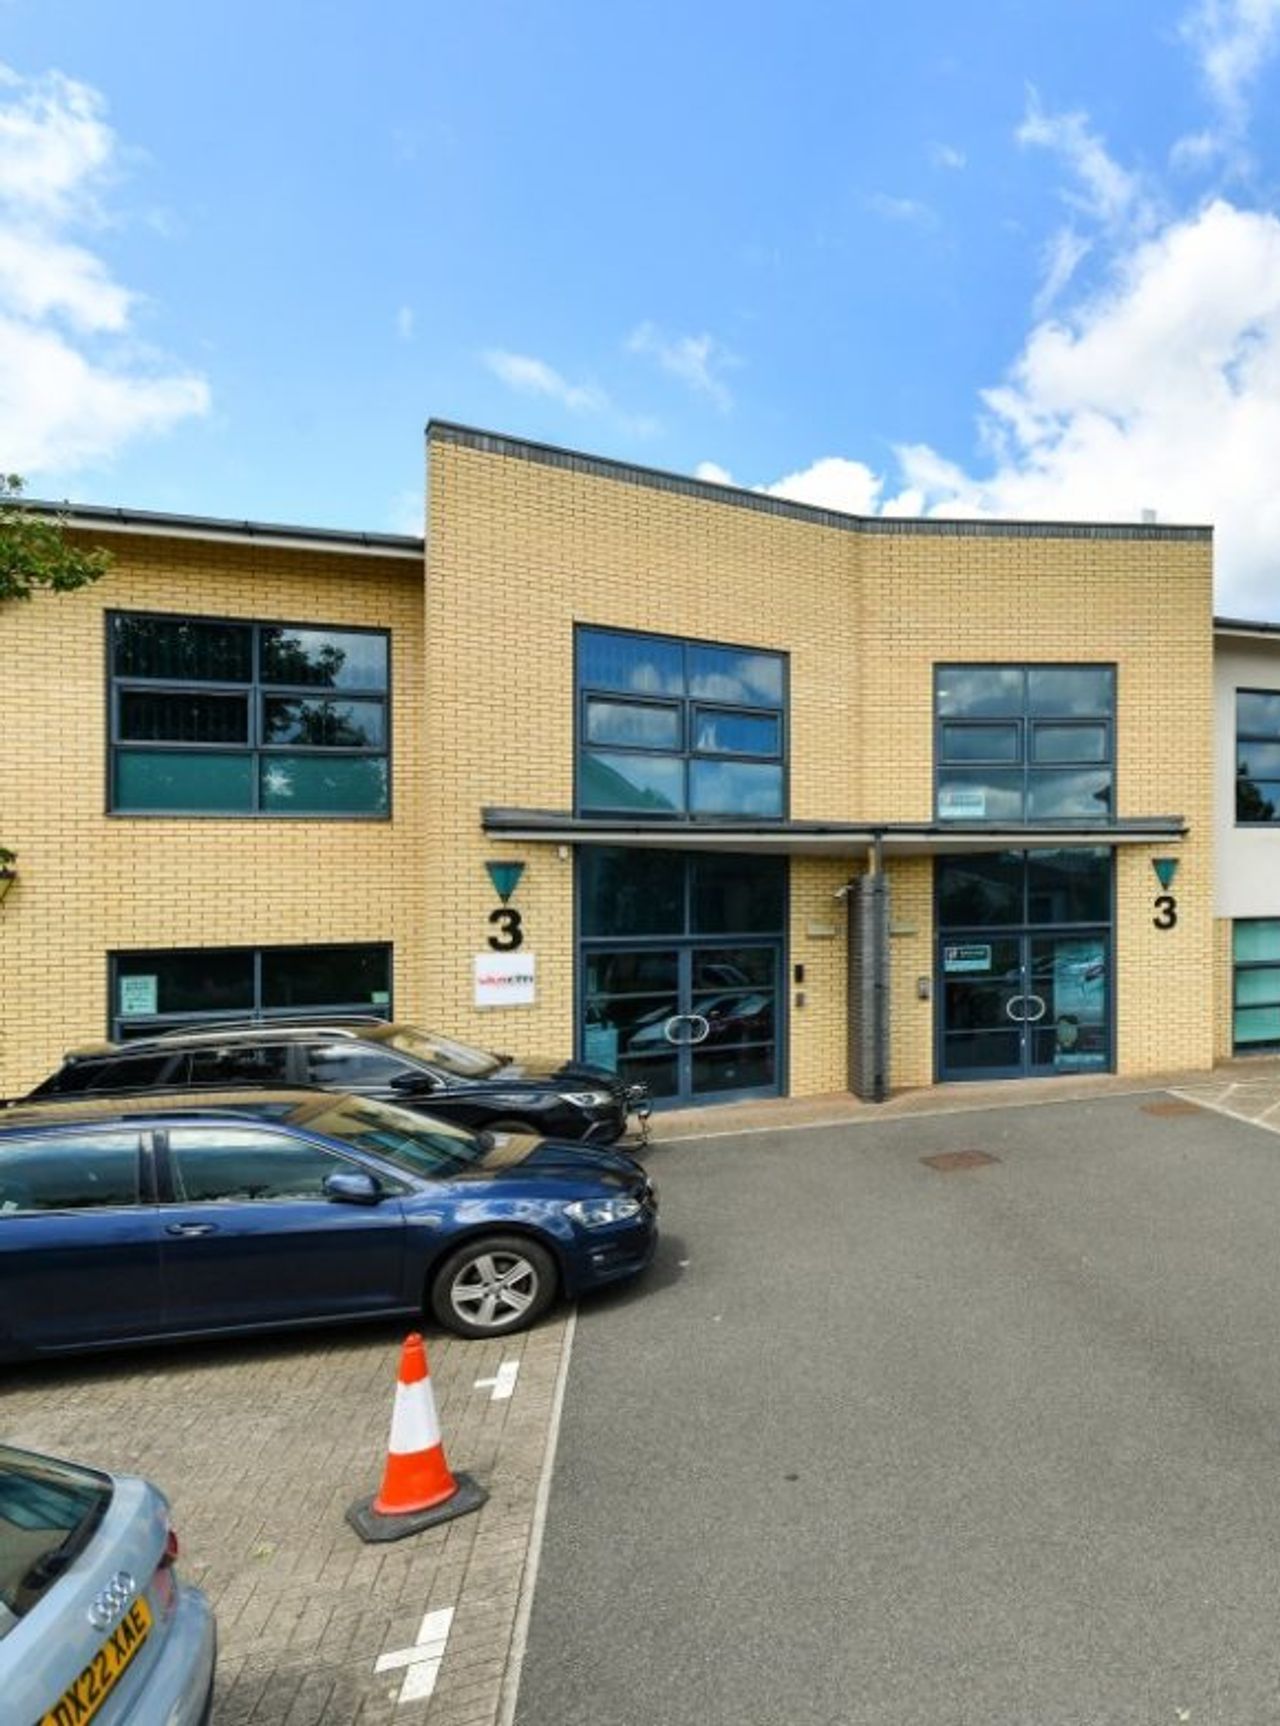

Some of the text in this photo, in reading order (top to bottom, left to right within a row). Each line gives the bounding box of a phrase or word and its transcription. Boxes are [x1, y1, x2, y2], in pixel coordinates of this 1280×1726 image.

[488, 908, 523, 952] 3
[1153, 896, 1177, 930] 3
[109, 1600, 147, 1665] XAE
